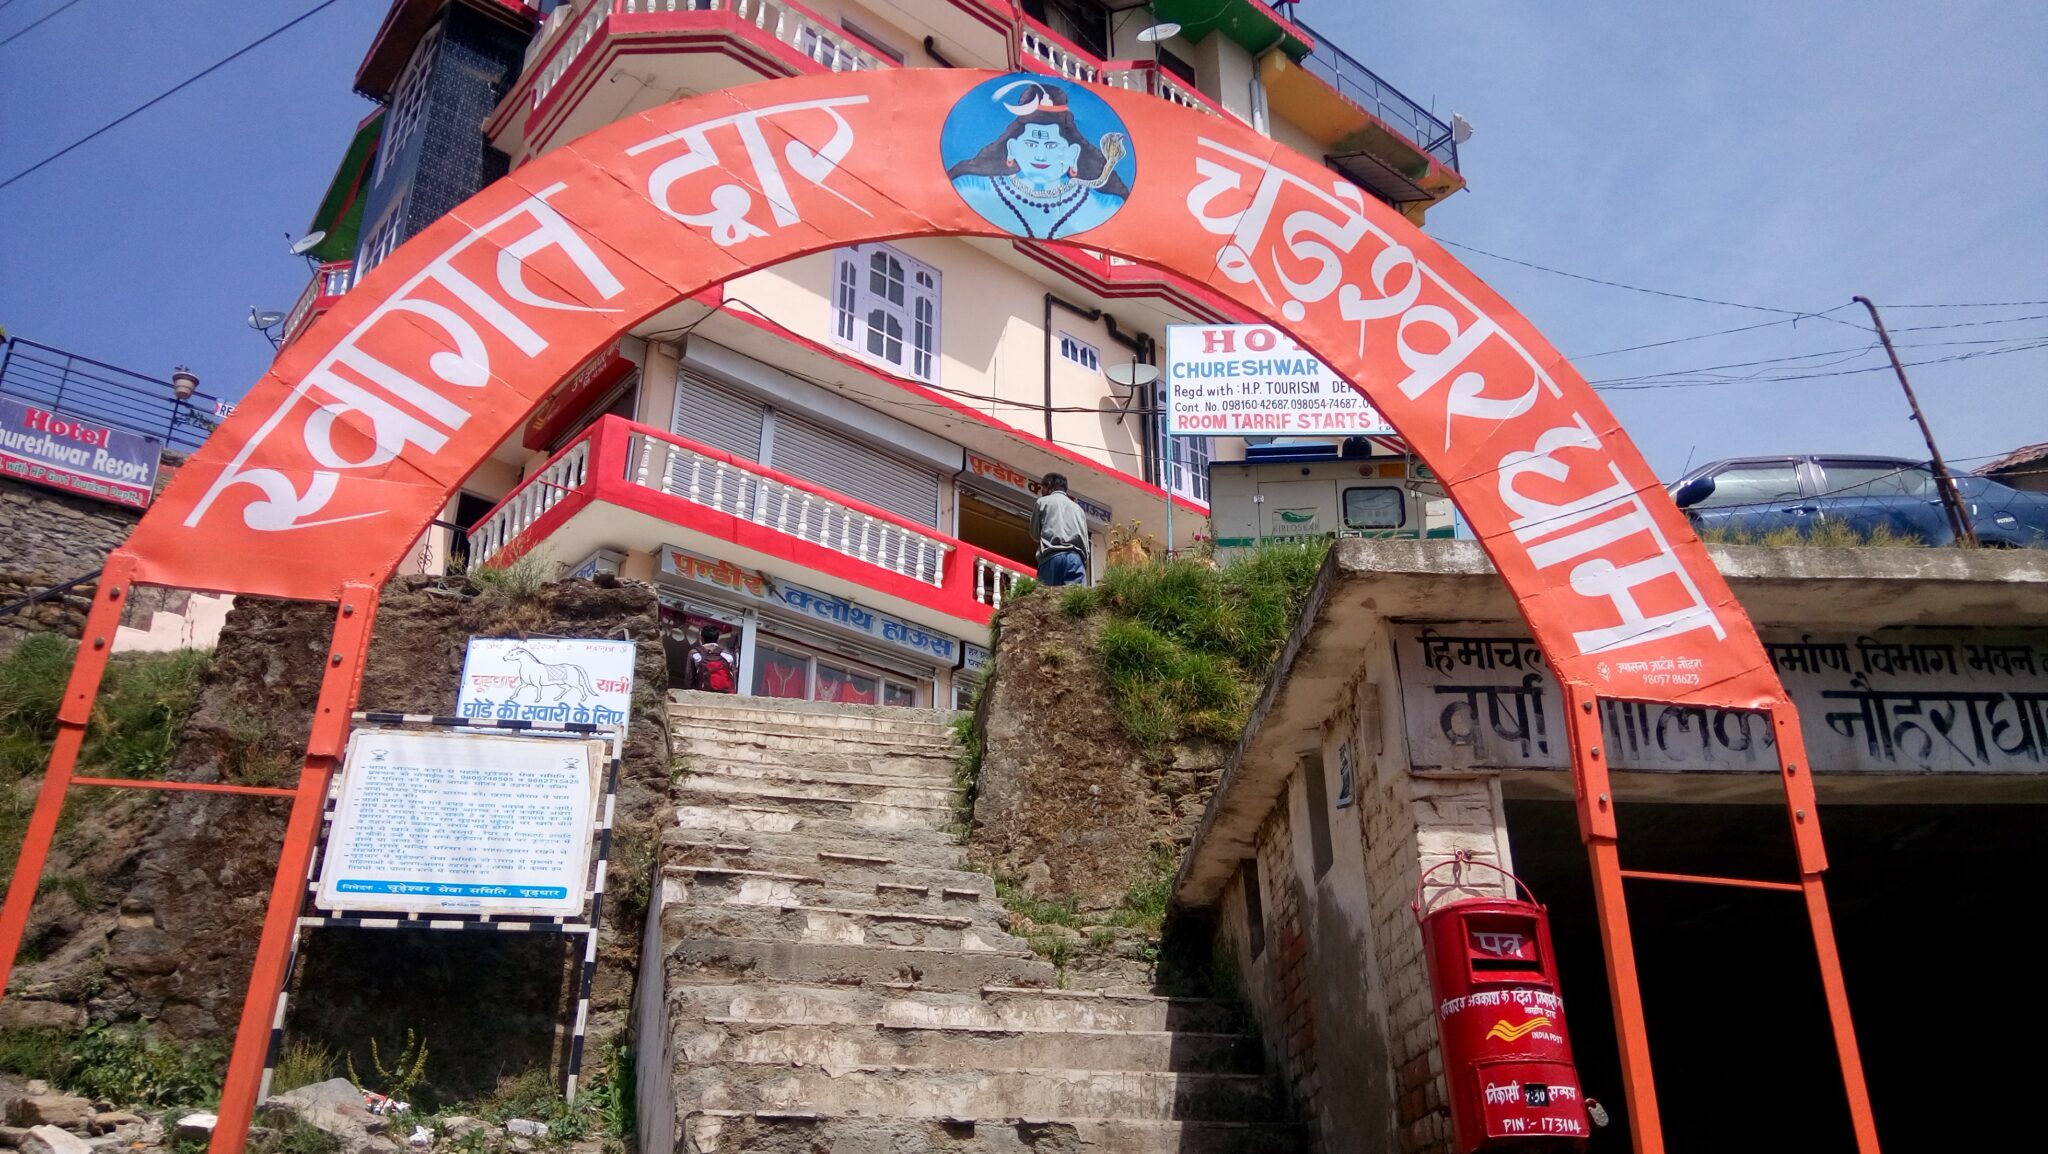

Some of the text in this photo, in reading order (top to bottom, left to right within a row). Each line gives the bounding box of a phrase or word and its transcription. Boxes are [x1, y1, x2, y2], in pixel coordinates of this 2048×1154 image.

[184, 94, 873, 531] स्वागत द्वार
[1202, 329, 1306, 353] HO
[1173, 359, 1319, 378] CHURESHWAR
[1242, 382, 1262, 395] H.P.
[1266, 381, 1320, 395] TOURISM
[1205, 402, 1220, 411] No.
[22, 407, 110, 449] Hotel
[1178, 414, 1228, 430] ROOM
[1232, 413, 1291, 430] TARRIF
[1297, 411, 1371, 429] STARTS
[92, 448, 149, 482] Resort
[1497, 411, 1726, 655] धाम
[1855, 635, 1958, 676] विभाग
[596, 676, 630, 694] यात्री
[496, 700, 521, 721] की
[522, 702, 571, 723] सवारी
[573, 703, 590, 724] के
[592, 705, 625, 726] लिए
[1820, 671, 2048, 773] नौहराधा
[438, 885, 462, 893] सेवा
[1472, 932, 1523, 958] पत्र
[1510, 986, 1533, 1006] दिन
[1531, 1032, 1563, 1043] INDIA POST
[1541, 1117, 1582, 1135] 173104
